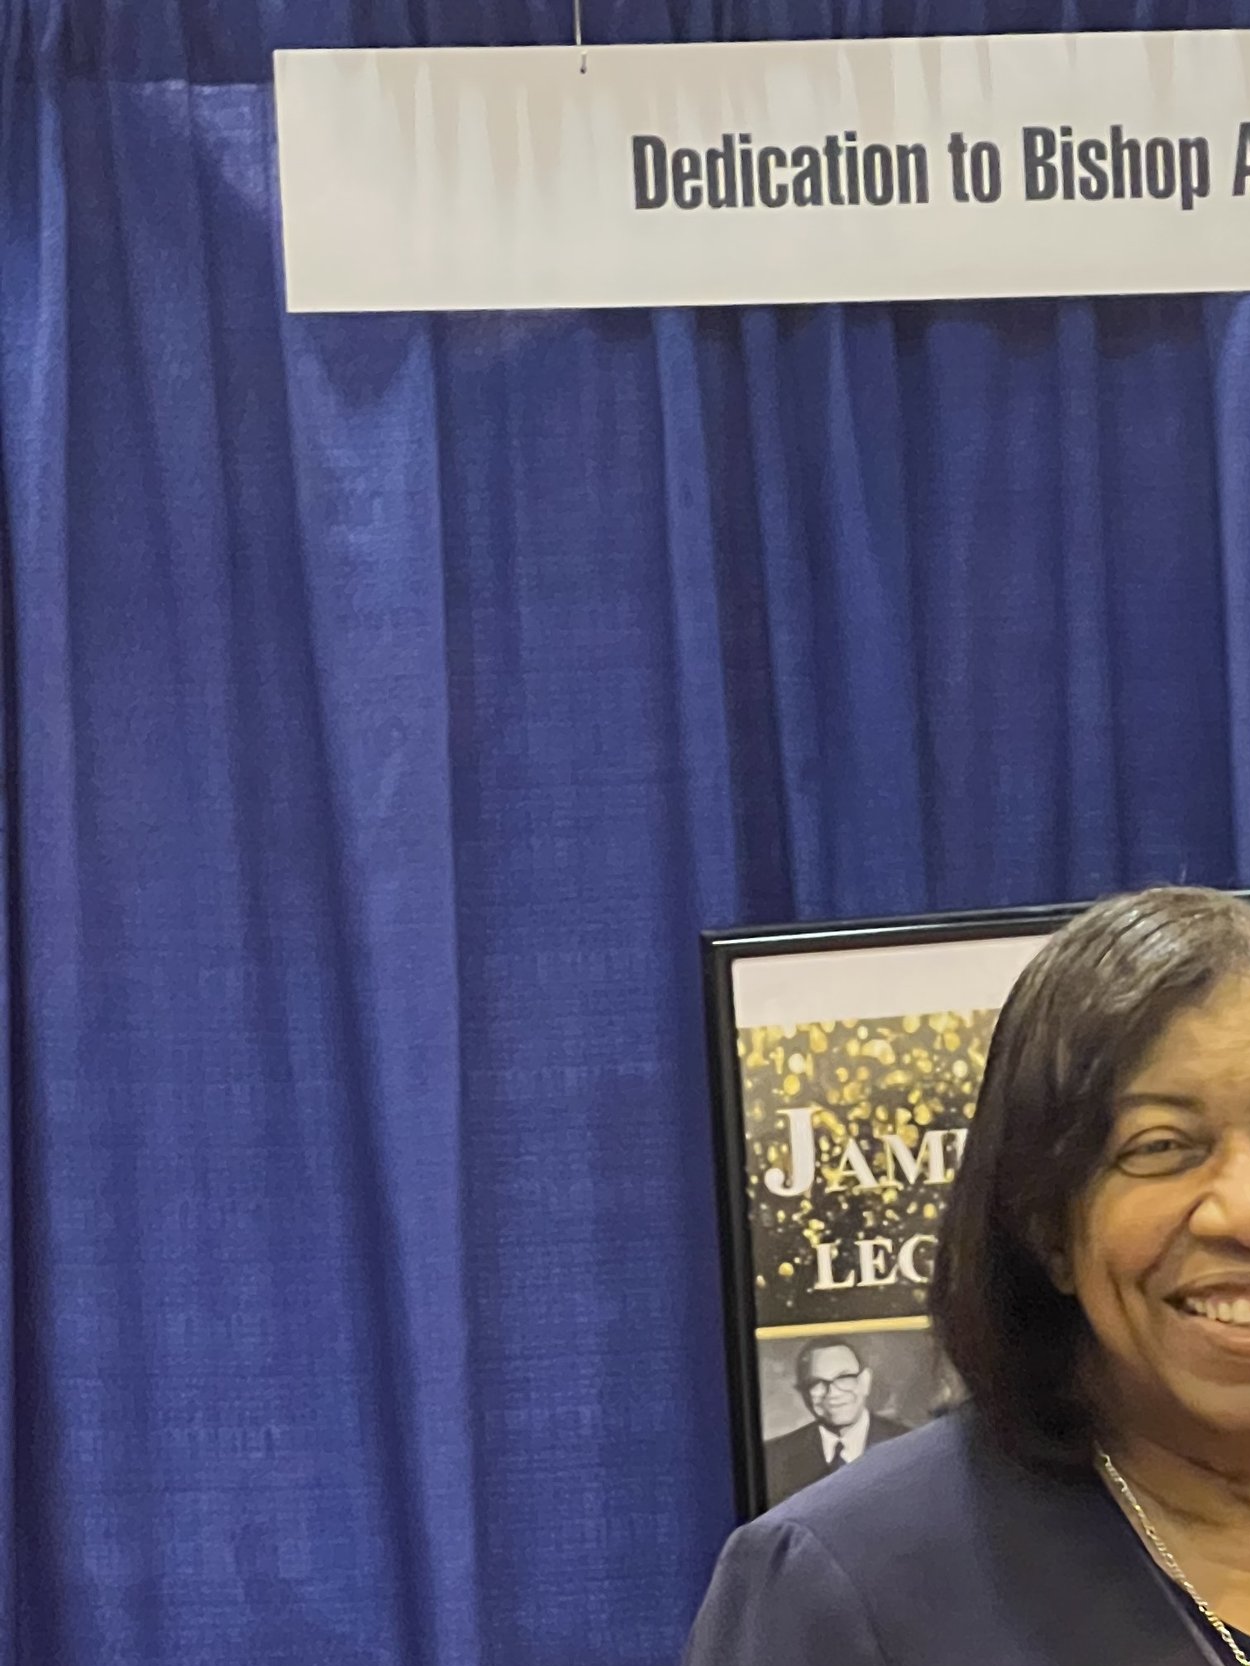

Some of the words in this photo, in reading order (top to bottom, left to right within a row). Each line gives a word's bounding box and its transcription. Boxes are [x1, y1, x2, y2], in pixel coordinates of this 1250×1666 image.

[632, 130, 930, 210] Dedication
[948, 131, 1002, 202] to
[1023, 125, 1210, 211] Bishop
